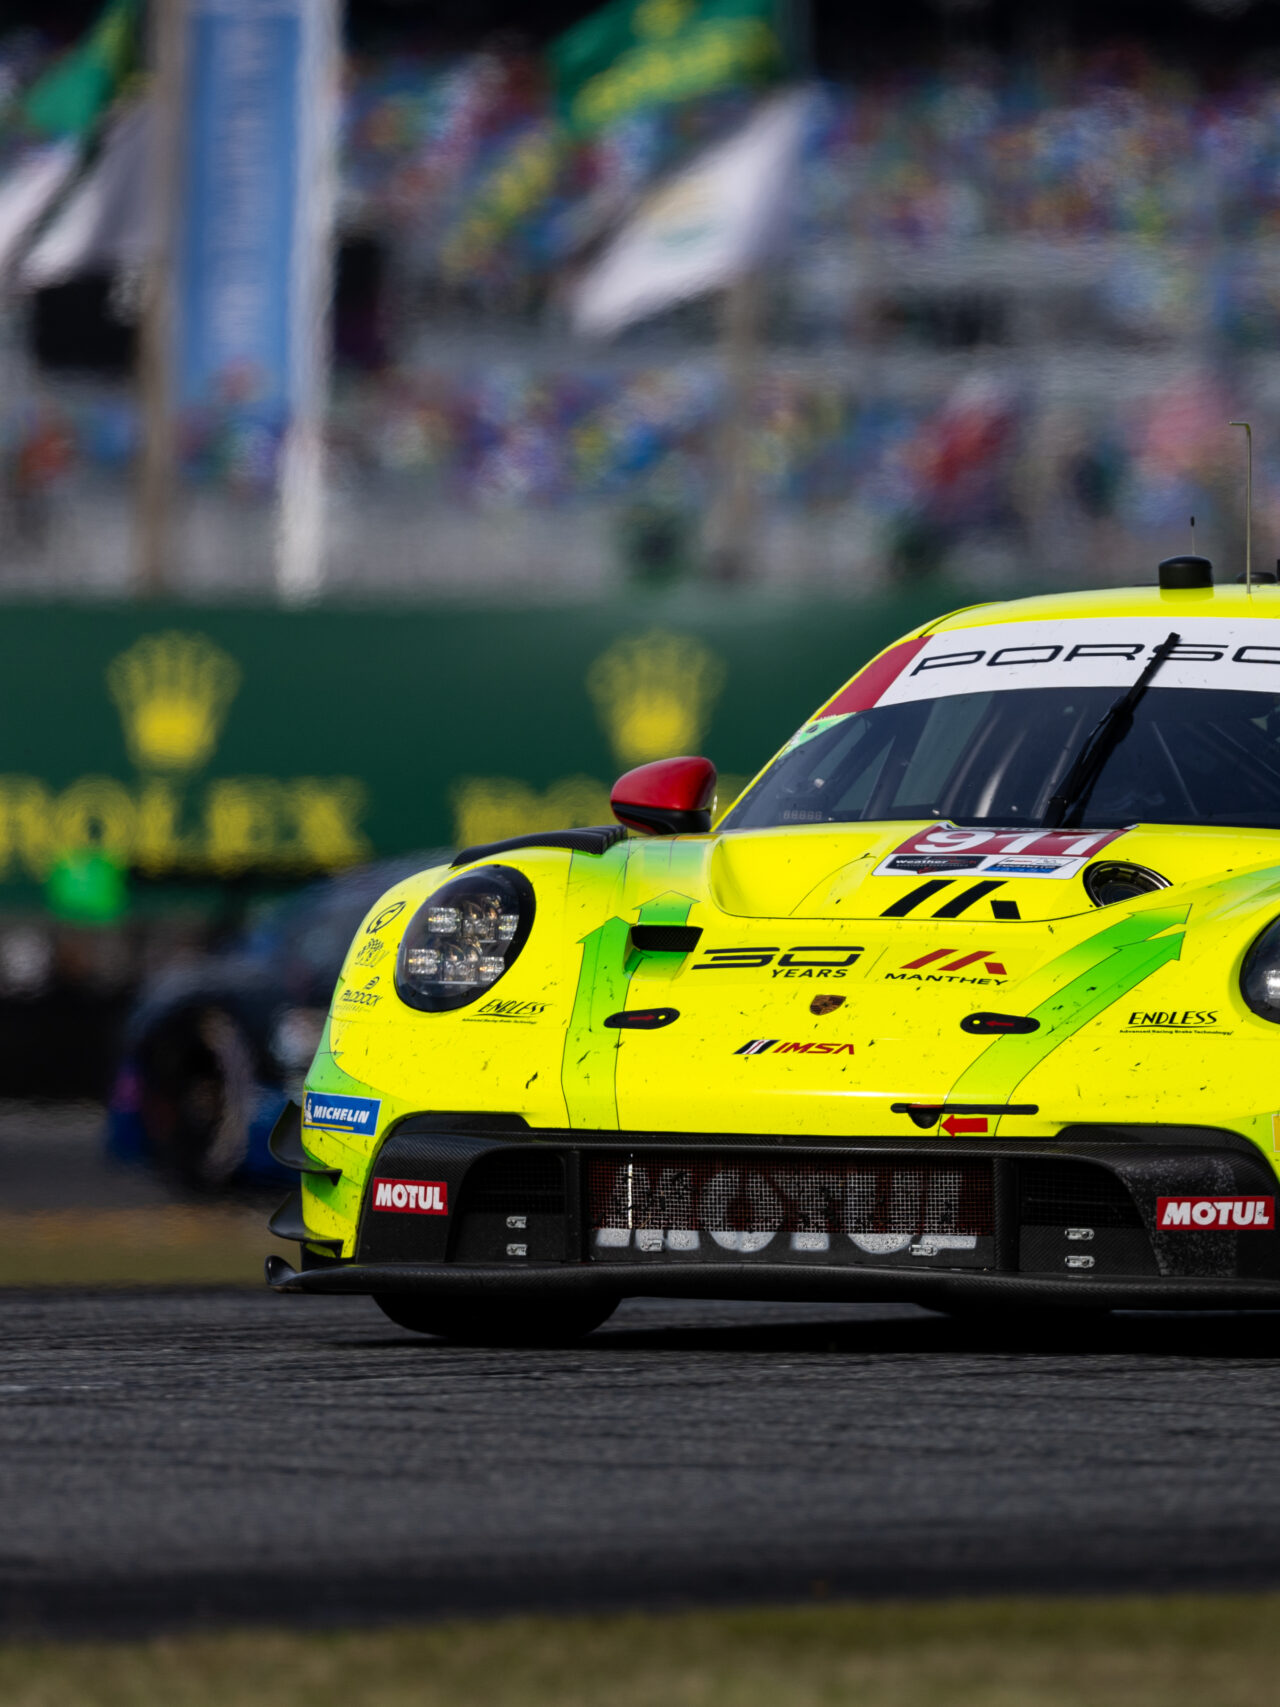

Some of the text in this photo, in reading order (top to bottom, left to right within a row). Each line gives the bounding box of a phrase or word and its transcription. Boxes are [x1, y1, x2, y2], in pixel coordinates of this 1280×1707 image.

[914, 829, 1117, 855] 911
[690, 946, 865, 970] 30
[771, 968, 849, 979] YEARS
[884, 972, 1009, 987] MANTHEY
[477, 998, 553, 1015] ENDLESS
[1128, 1010, 1220, 1025] ENDLESS
[772, 1041, 856, 1055] IMSA
[313, 1105, 371, 1125] MICHELIN
[375, 1183, 444, 1210] MOTUL
[1161, 1201, 1270, 1226] MOTUL
